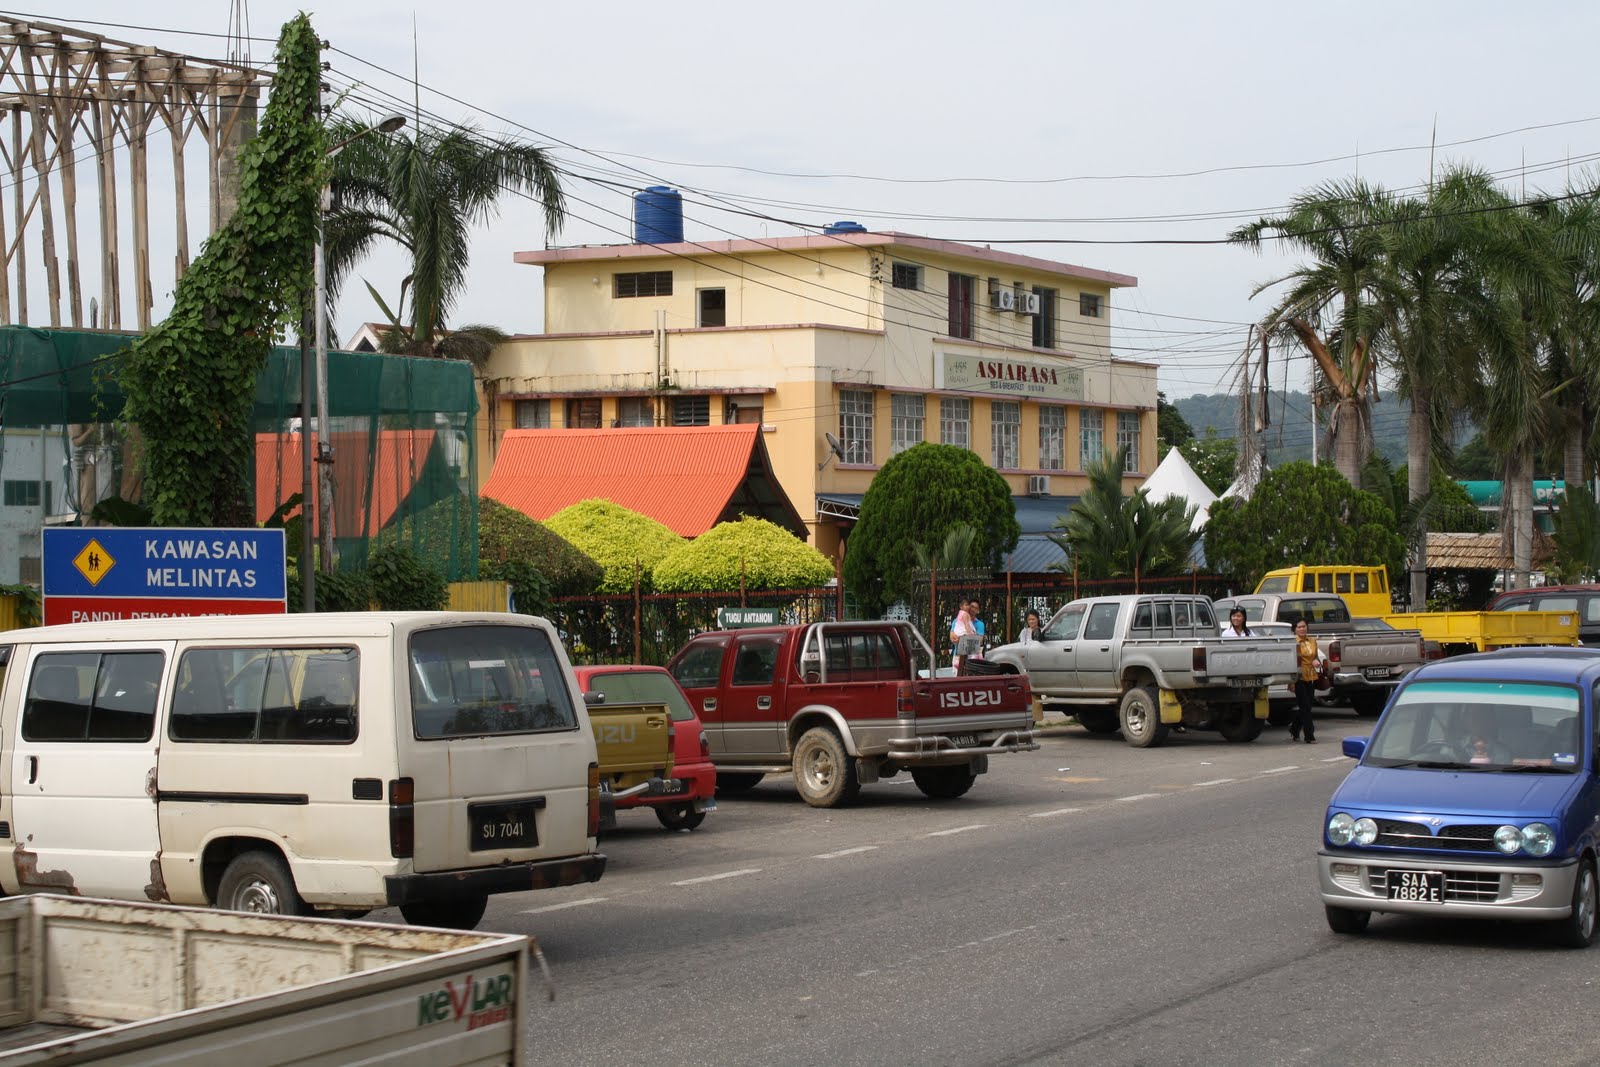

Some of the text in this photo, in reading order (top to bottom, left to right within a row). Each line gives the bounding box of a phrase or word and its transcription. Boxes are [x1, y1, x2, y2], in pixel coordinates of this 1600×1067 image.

[976, 360, 1058, 385] ASIARASA
[145, 540, 257, 560] KAWASAN
[146, 568, 257, 588] MELINTAS
[725, 612, 773, 624] TUGU ANTANOM
[940, 689, 1002, 708] ISUZU
[483, 822, 523, 838] SU 7041
[1402, 873, 1429, 888] SAA
[1391, 886, 1439, 901] 7882 E
